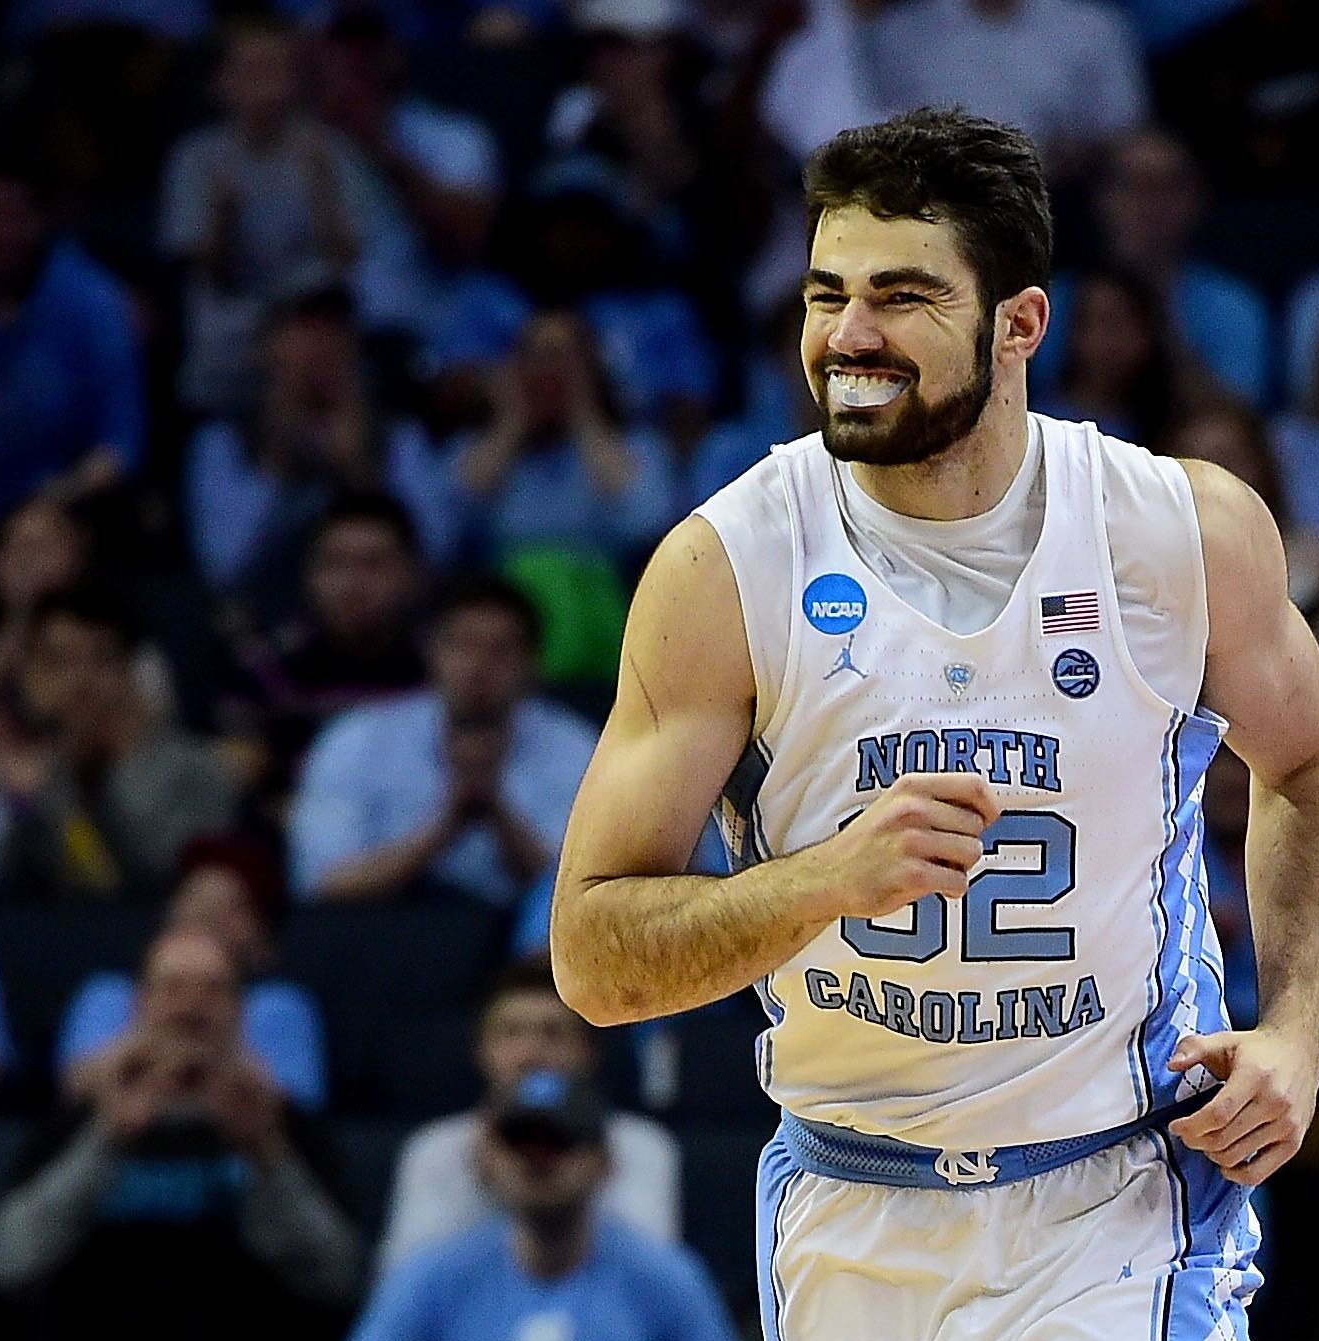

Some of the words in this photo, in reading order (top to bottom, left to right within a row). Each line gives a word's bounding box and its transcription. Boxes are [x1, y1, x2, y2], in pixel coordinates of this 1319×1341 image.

[811, 601, 863, 618] NCAA
[1059, 663, 1095, 678] ACC
[855, 727, 1062, 792] NORTH
[805, 967, 1105, 1045] CAROLINA
